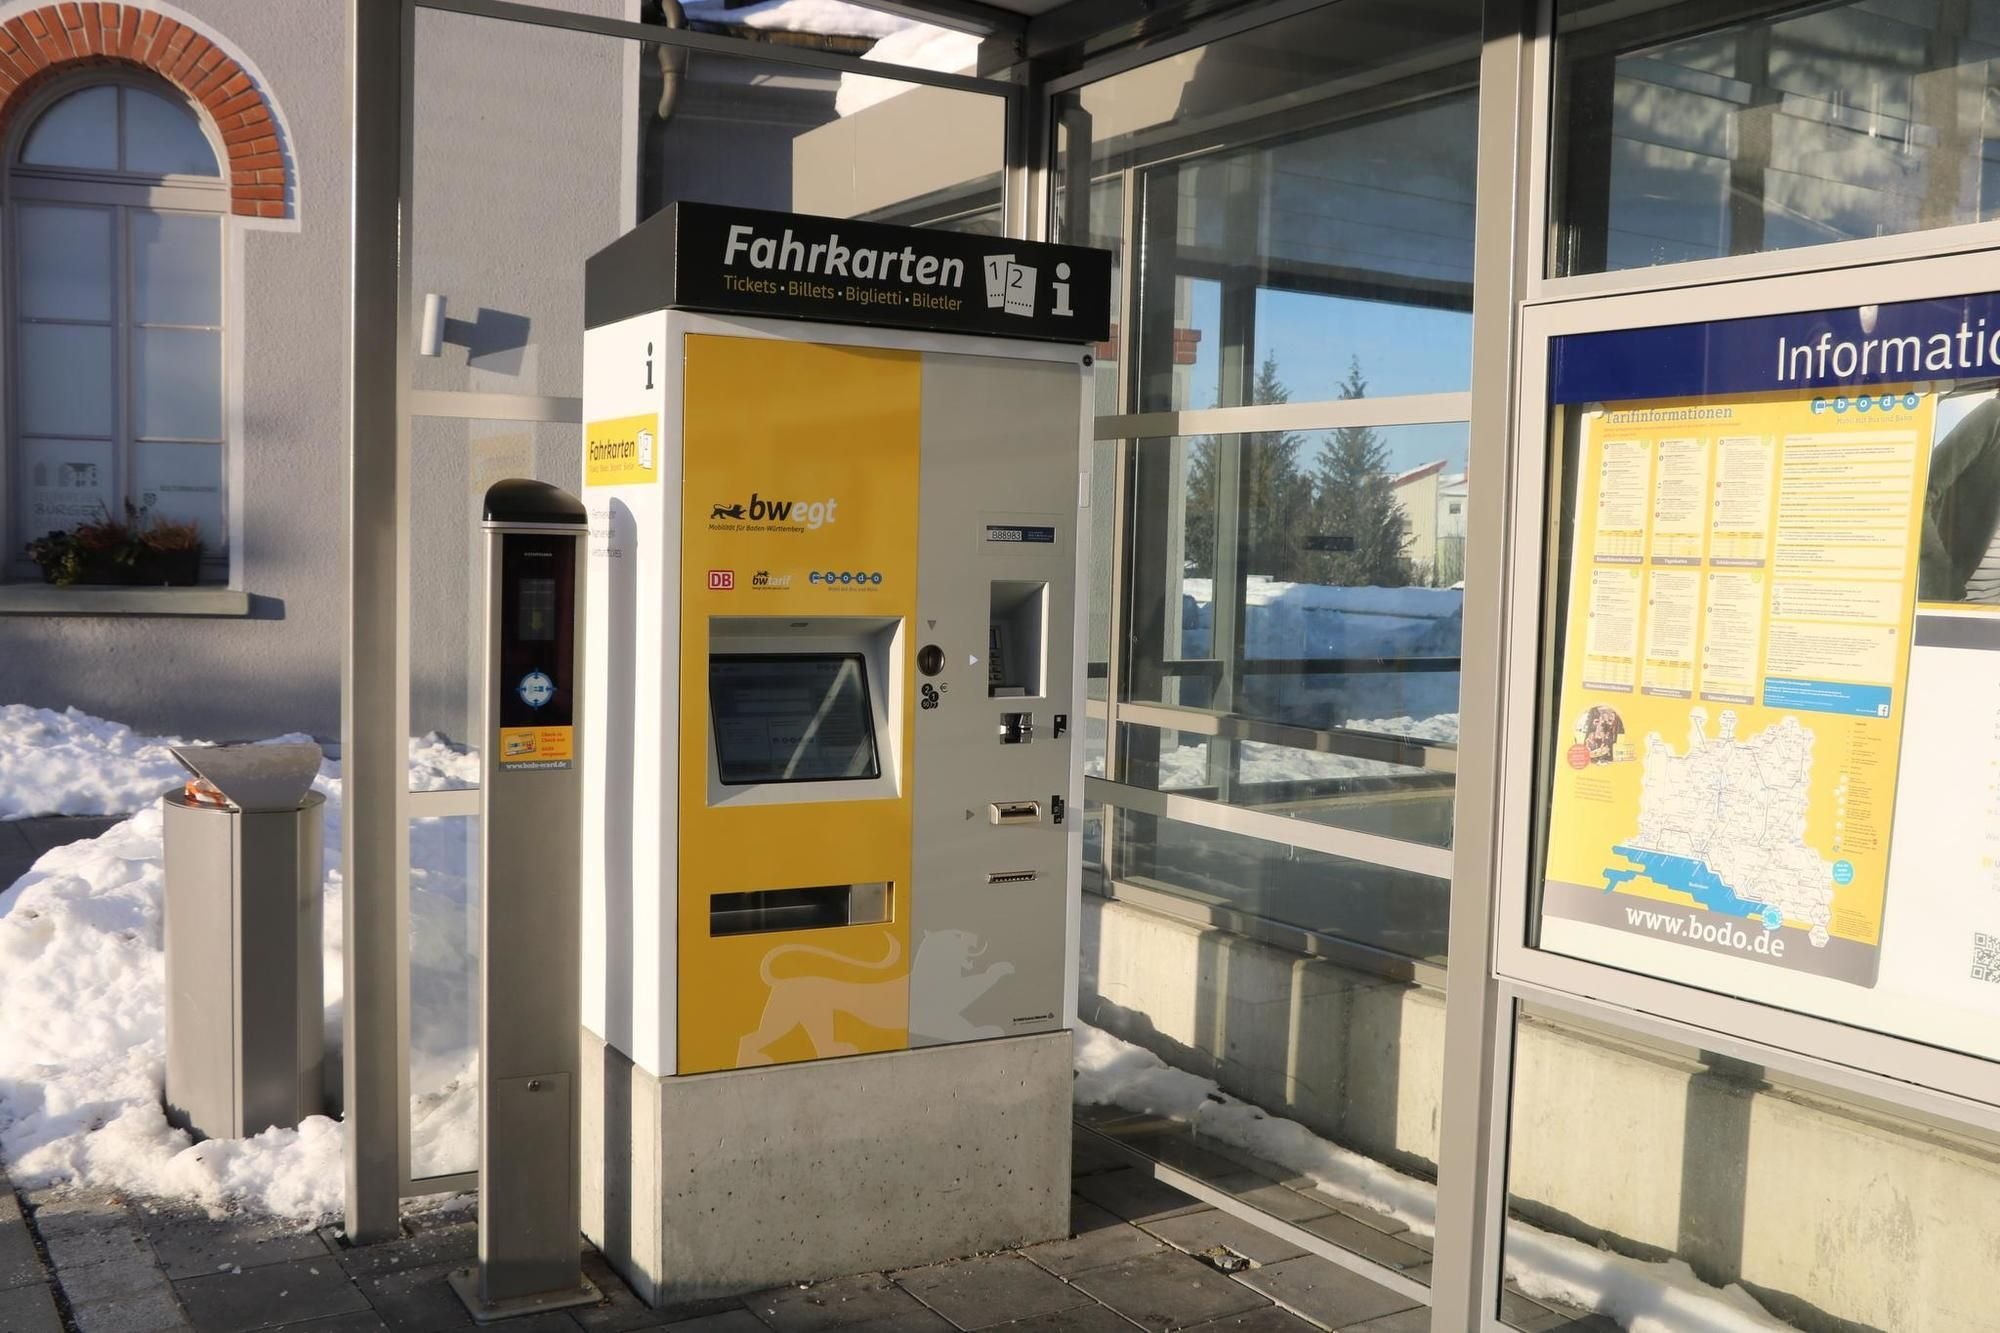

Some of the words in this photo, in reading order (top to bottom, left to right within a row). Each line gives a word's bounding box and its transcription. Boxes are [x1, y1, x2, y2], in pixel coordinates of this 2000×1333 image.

[724, 224, 964, 287] Fahrkarten
[723, 274, 777, 294] Tickets
[788, 280, 835, 300] Billets
[845, 286, 902, 306] Biglietti
[912, 292, 962, 312] Biletler
[1605, 406, 1733, 424] Tarifinformationen
[590, 438, 636, 461] Fahrkarten
[749, 492, 838, 530] bwegt
[711, 573, 732, 587] DB
[1625, 907, 1785, 957] www.bodo.de
